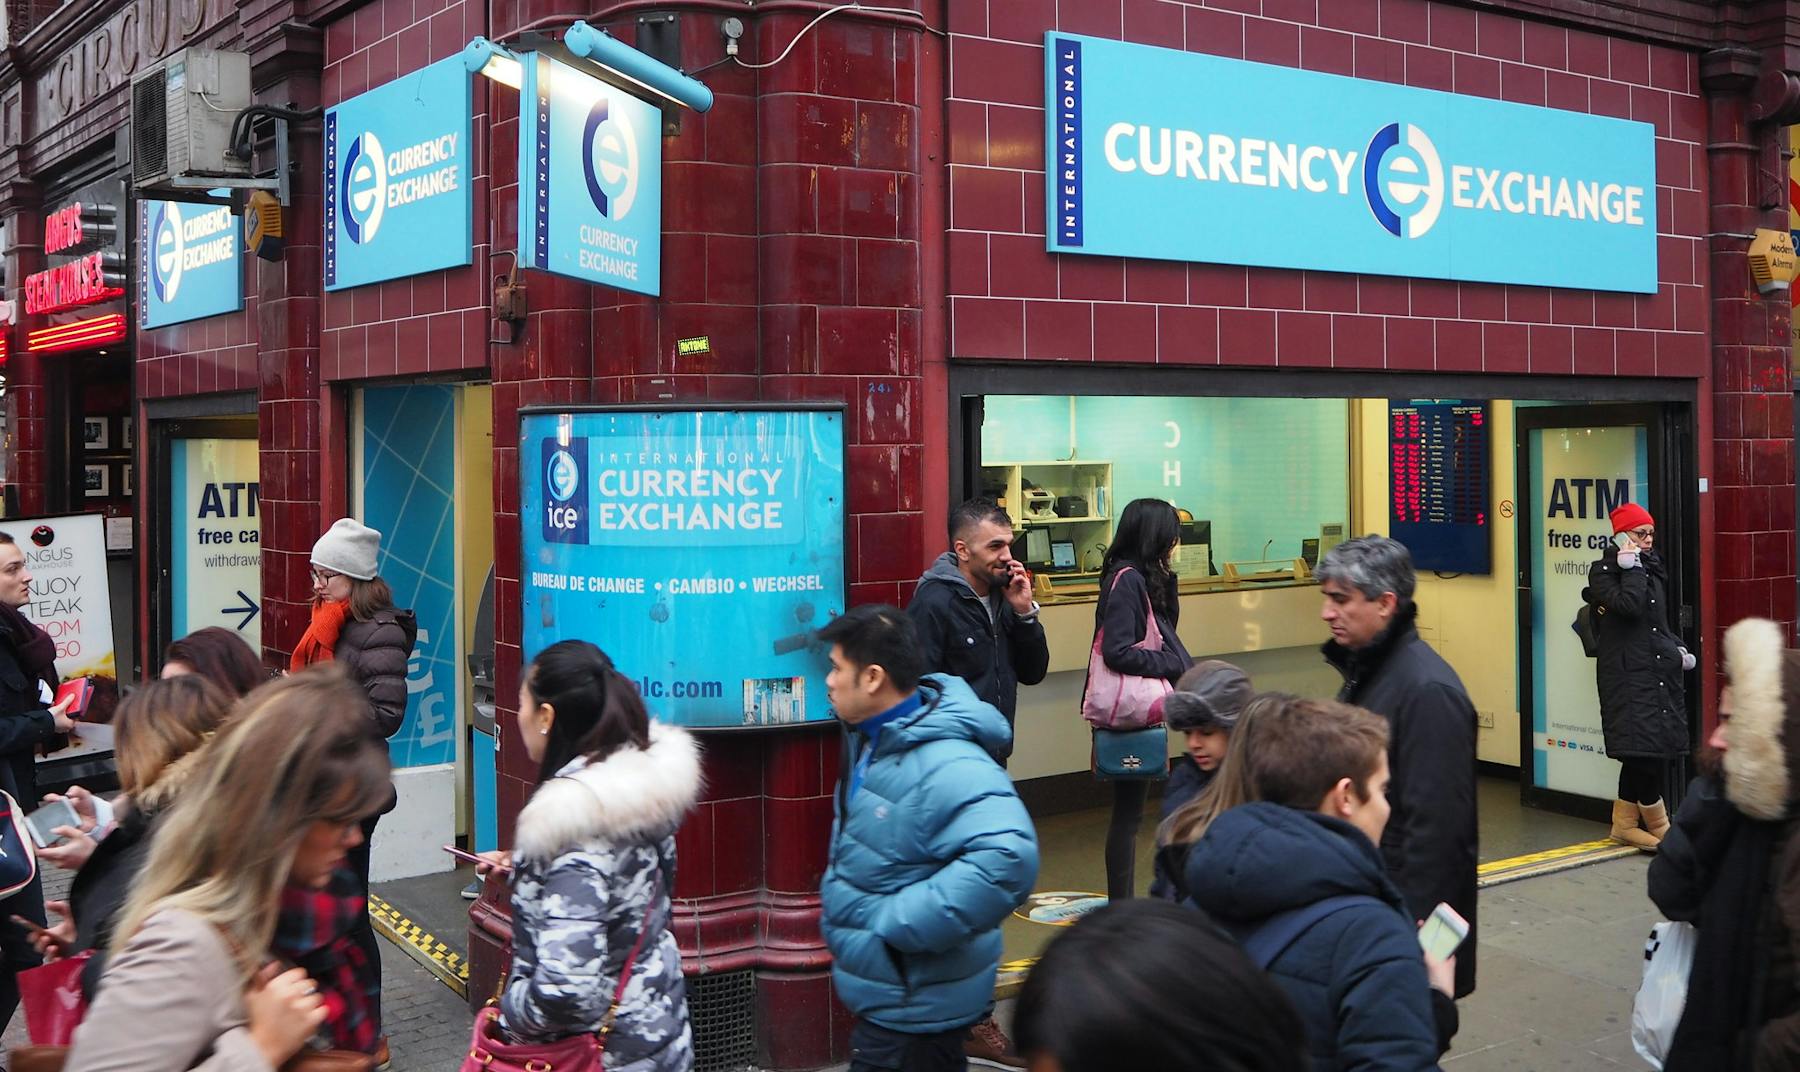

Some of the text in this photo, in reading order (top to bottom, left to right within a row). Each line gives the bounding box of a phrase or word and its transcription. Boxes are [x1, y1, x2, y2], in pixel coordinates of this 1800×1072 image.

[387, 131, 459, 177] CURRENCY
[1064, 49, 1076, 239] INTERNATIONAL
[387, 165, 458, 209] EXCHANGE
[538, 96, 548, 257] INTERNATION
[1104, 122, 1645, 226] CURRENCY EXCHANGE
[327, 119, 335, 278] INTERNATIONAL
[184, 205, 232, 242] CURRENCY
[184, 235, 234, 271] EXCHANGE
[579, 223, 639, 256] CURRENCY
[578, 251, 639, 281] EXCHANGE
[600, 452, 784, 465] INTERNATIONAL
[599, 469, 784, 498] CURRENCY
[1548, 478, 1629, 519] ATM
[548, 501, 578, 529] ice
[600, 502, 783, 530] EXCHANGE
[198, 528, 233, 544] free
[1548, 529, 1581, 548] free
[24, 546, 73, 563] NGUS
[1555, 560, 1590, 576] withdr
[28, 576, 81, 597] NJOY
[532, 571, 823, 595] BUREAU DE CHANGE CAMBIO WECHSEL
[27, 596, 83, 618] TEAK
[55, 640, 80, 658] 50
[633, 676, 722, 698] lc.com
